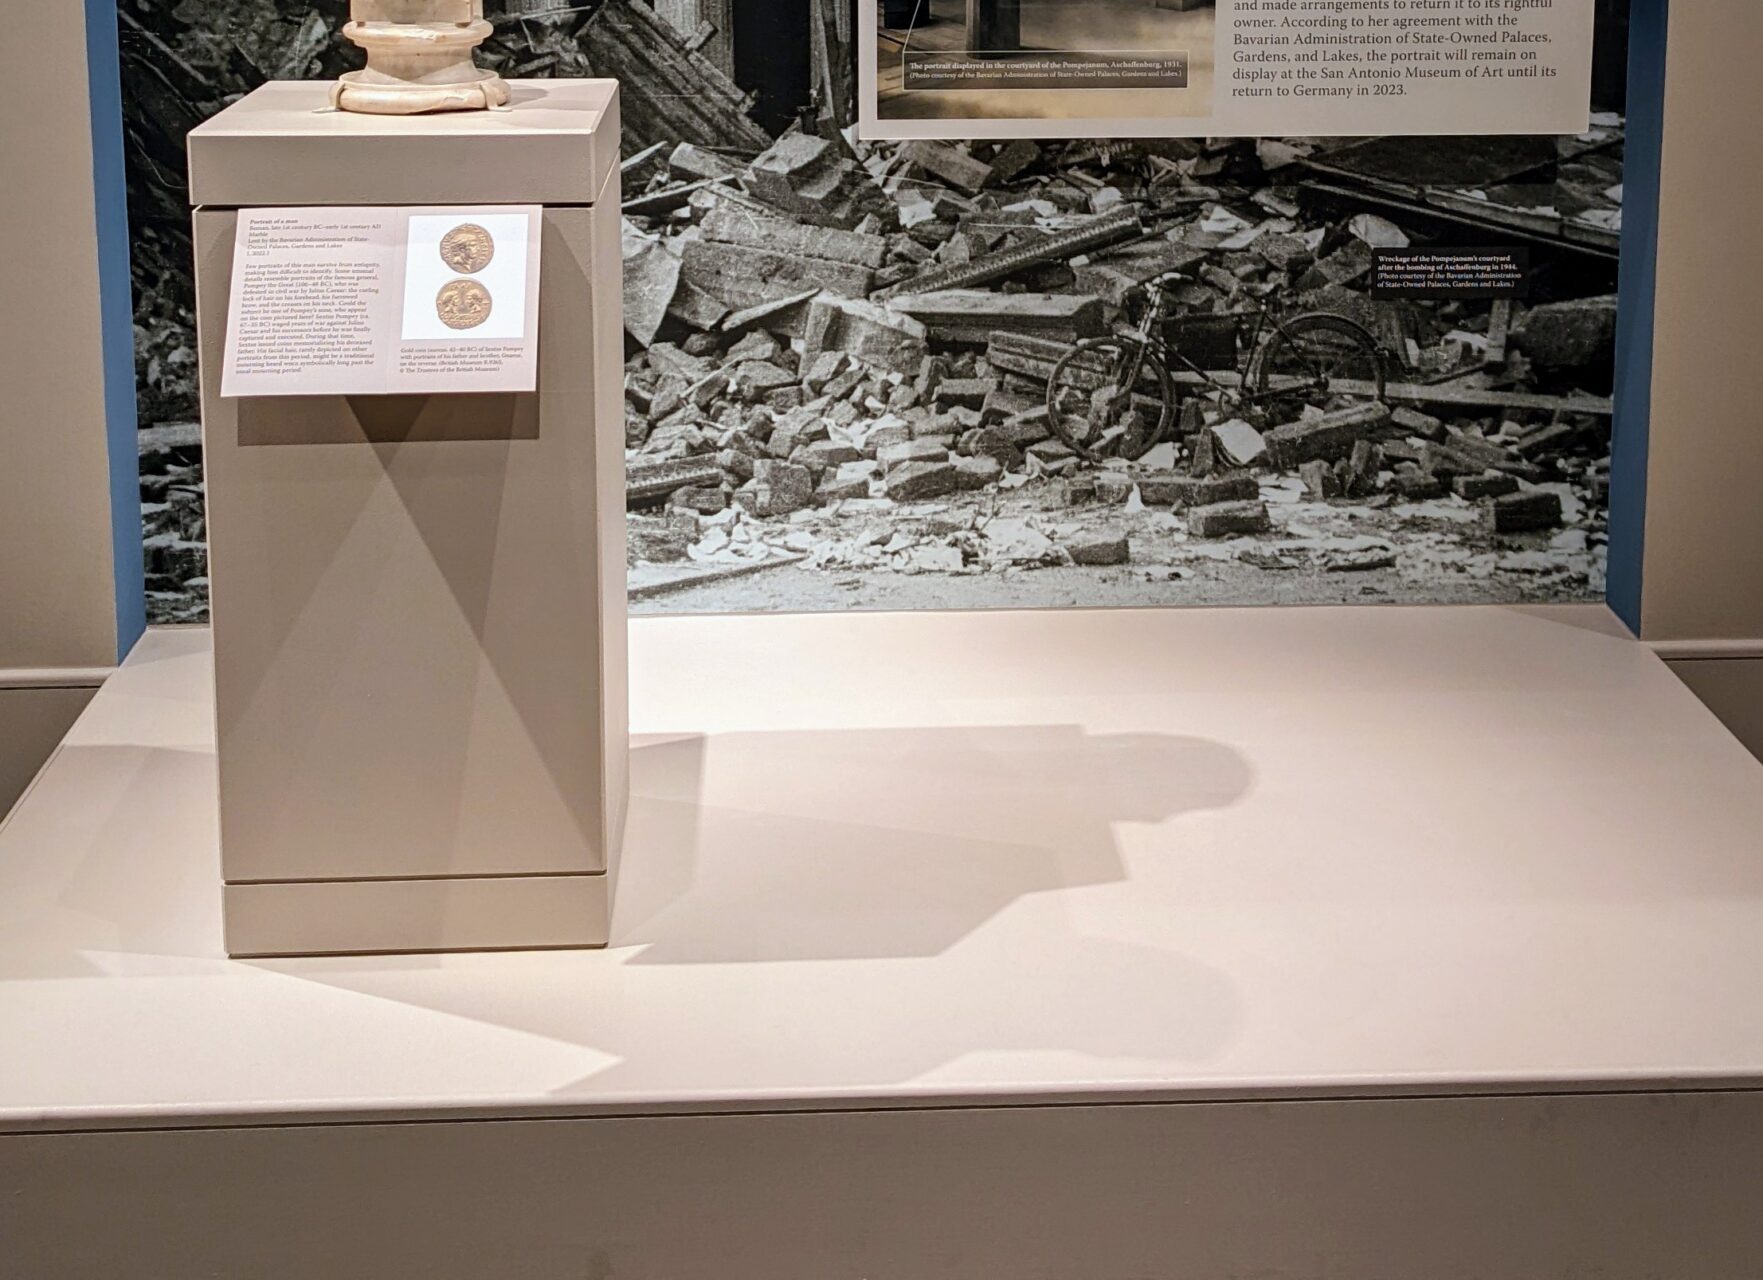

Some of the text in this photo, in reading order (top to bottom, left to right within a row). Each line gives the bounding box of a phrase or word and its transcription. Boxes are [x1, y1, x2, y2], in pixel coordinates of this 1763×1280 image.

[924, 62, 951, 71] portrait
[952, 62, 985, 71] displayed
[986, 61, 993, 69] in
[994, 61, 1006, 69] the
[1007, 61, 1040, 70] courtyard
[1042, 61, 1050, 69] of
[1050, 61, 1062, 69] the
[1233, 65, 1556, 82] display at the San Antonio Museum of Art until its
[1232, 84, 1406, 99] return to Germany in 2023.
[1378, 255, 1410, 264] Wreckage
[1411, 255, 1419, 263] of
[1420, 255, 1430, 263] the
[1479, 255, 1510, 264] courtyard
[1406, 264, 1435, 272] bombing
[1436, 263, 1444, 271] of
[1492, 263, 1499, 271] in
[1377, 272, 1399, 281] (Photo
[1400, 273, 1425, 281] courtesy
[1427, 272, 1434, 280] of
[1435, 272, 1445, 280] the
[1446, 272, 1474, 280] Bavarian
[1427, 281, 1451, 289] Palaces,
[1480, 280, 1491, 288] and
